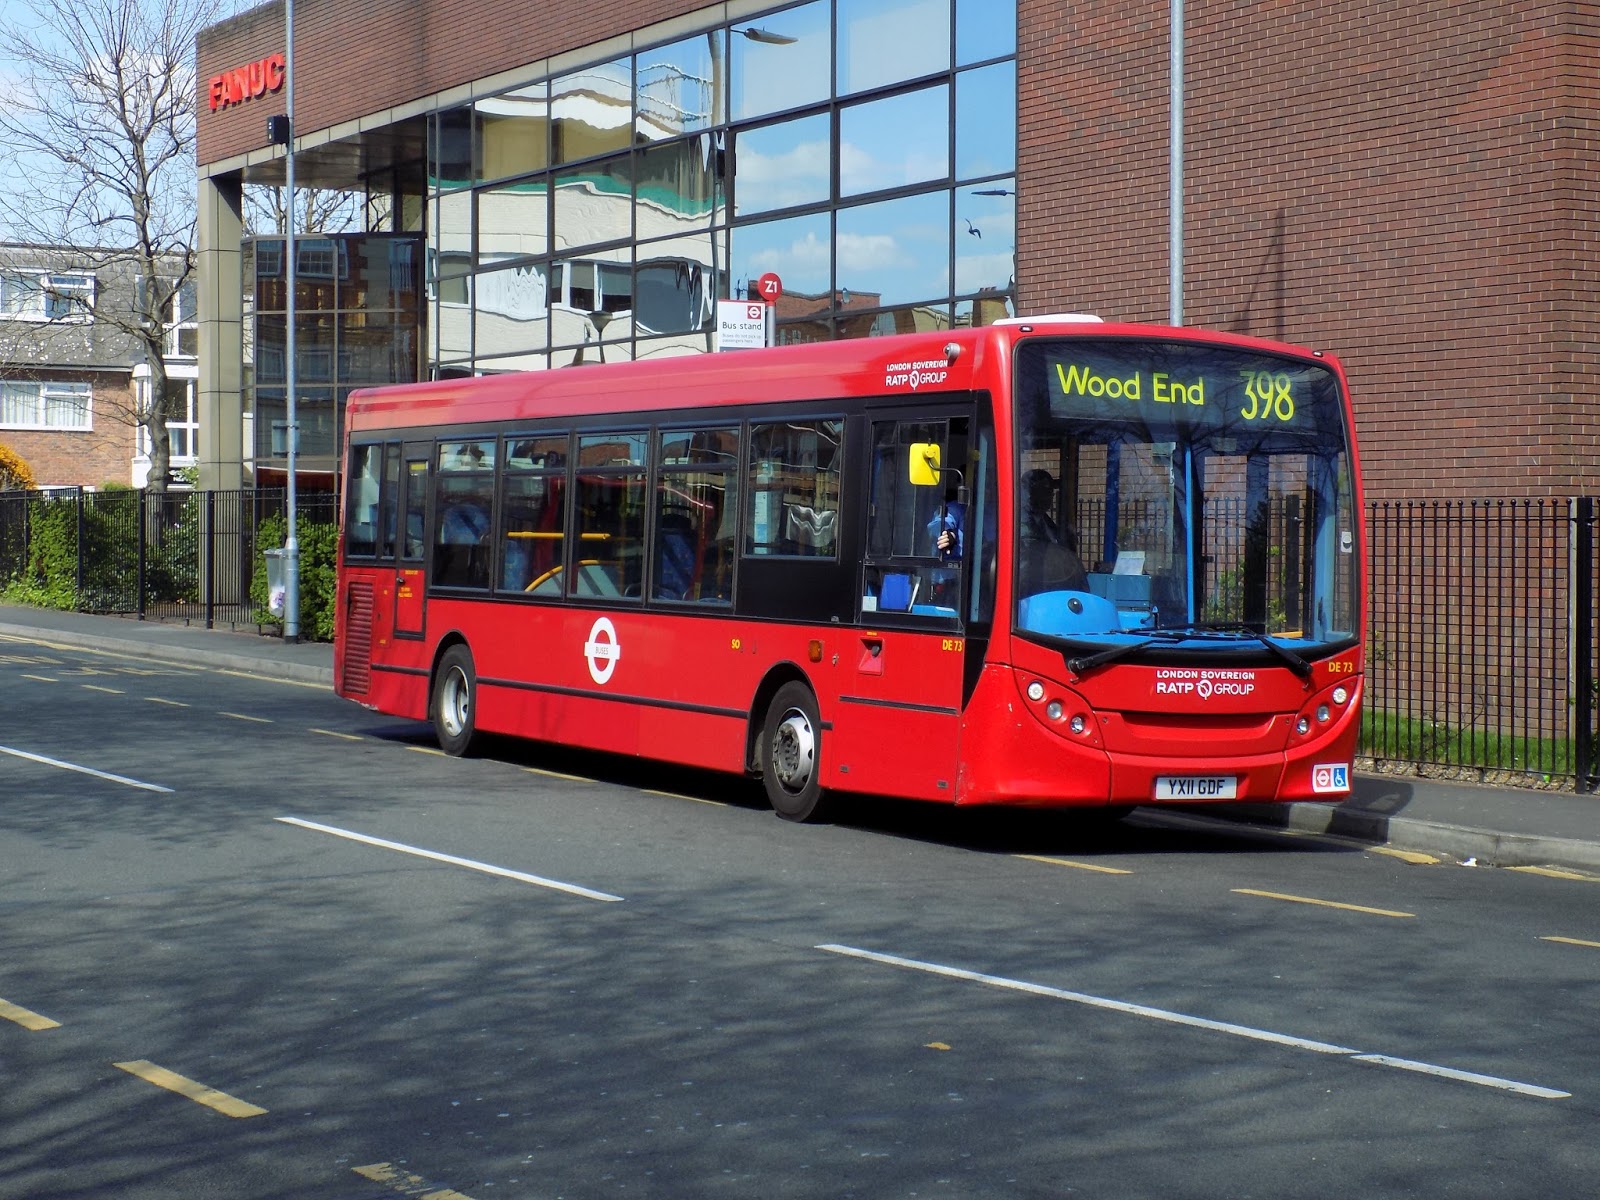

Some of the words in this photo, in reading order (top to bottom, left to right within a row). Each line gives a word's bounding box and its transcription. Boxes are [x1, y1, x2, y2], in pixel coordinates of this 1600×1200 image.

[208, 53, 285, 110] FANUC
[764, 280, 778, 294] Z1
[722, 321, 736, 329] Bus
[739, 322, 761, 330] stand
[886, 362, 911, 372] LONDON
[912, 359, 948, 370] SOVEREIGN
[885, 374, 908, 386] RATP
[920, 371, 947, 384] GROUP
[1056, 363, 1140, 400] Wood
[1153, 372, 1204, 405] End
[1240, 371, 1294, 421] 398
[595, 646, 609, 655] BUSES
[942, 639, 952, 650] DE
[954, 640, 963, 651] 73
[1328, 662, 1341, 672] DE
[1343, 662, 1353, 672] 73
[1156, 670, 1198, 679] LONDON
[1200, 671, 1255, 680] SOVEREIGN
[1156, 682, 1194, 694] RATP
[1213, 683, 1255, 695] GROUP
[1169, 779, 1194, 795] YX11
[1198, 779, 1225, 795] GDF
